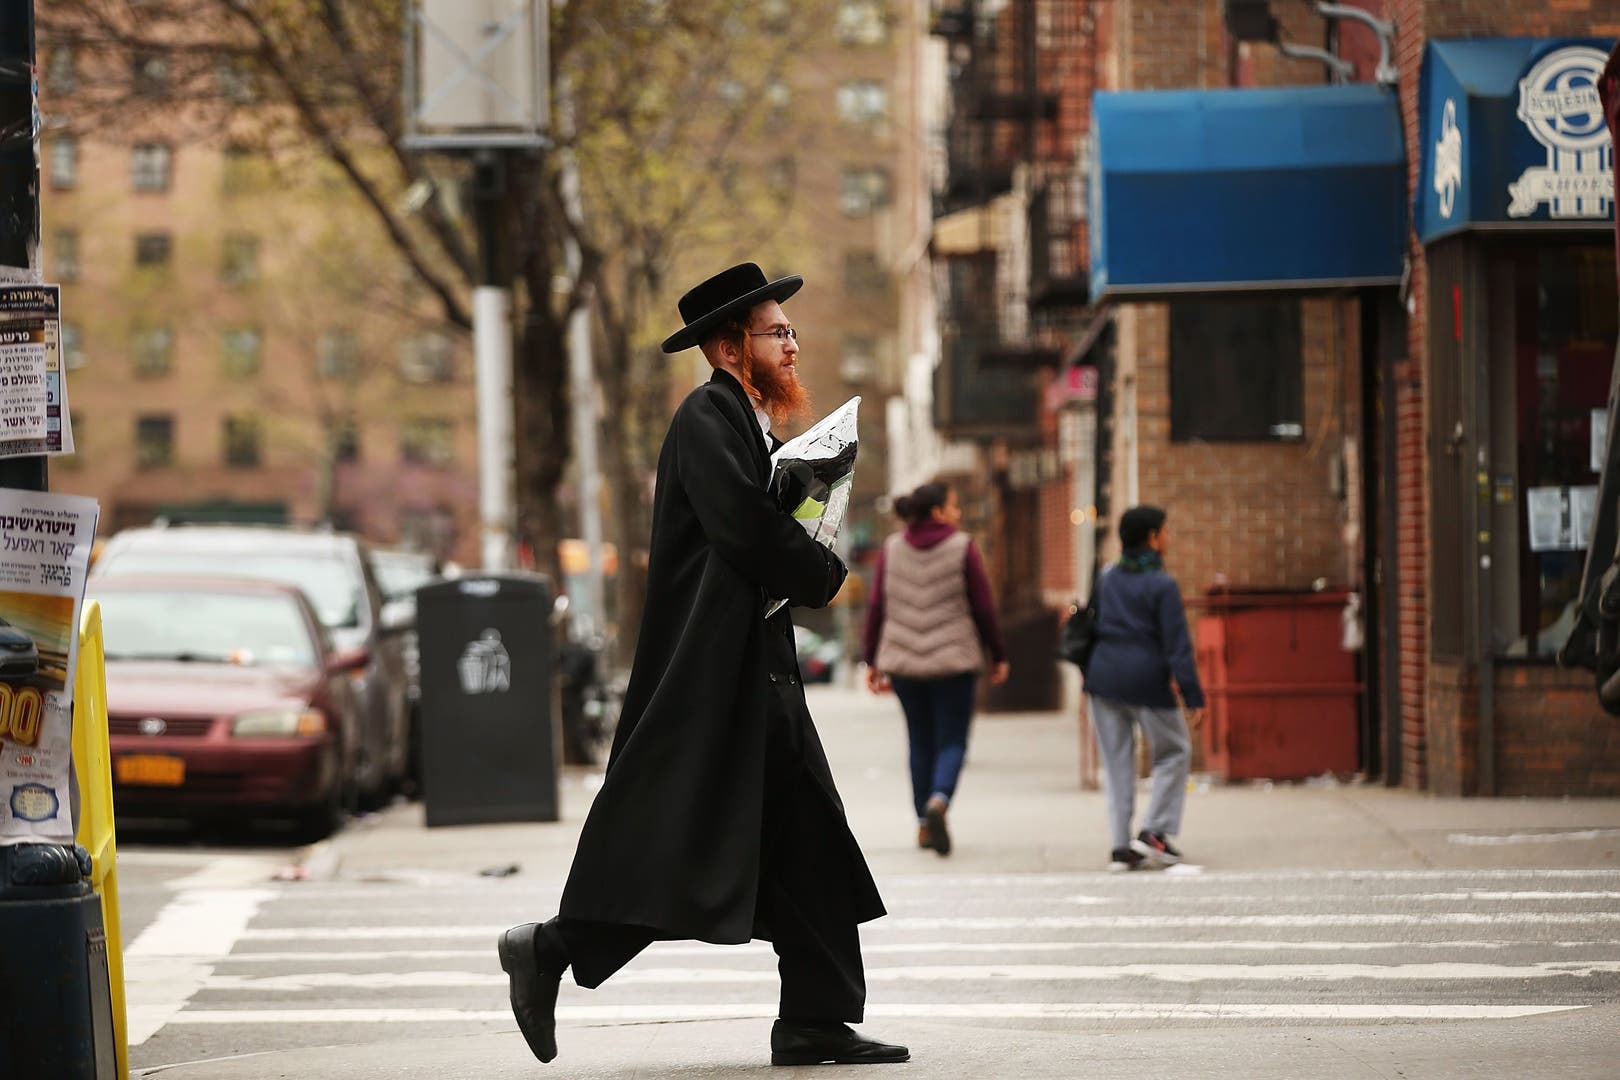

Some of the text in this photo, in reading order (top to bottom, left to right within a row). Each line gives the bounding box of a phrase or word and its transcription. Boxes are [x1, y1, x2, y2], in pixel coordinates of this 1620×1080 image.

[1531, 91, 1598, 109] SCHLESIN
[0, 331, 30, 342] פרש
[3, 416, 26, 427] אשר
[4, 531, 75, 560] קאר ראפעל
[40, 563, 71, 575] גרענד
